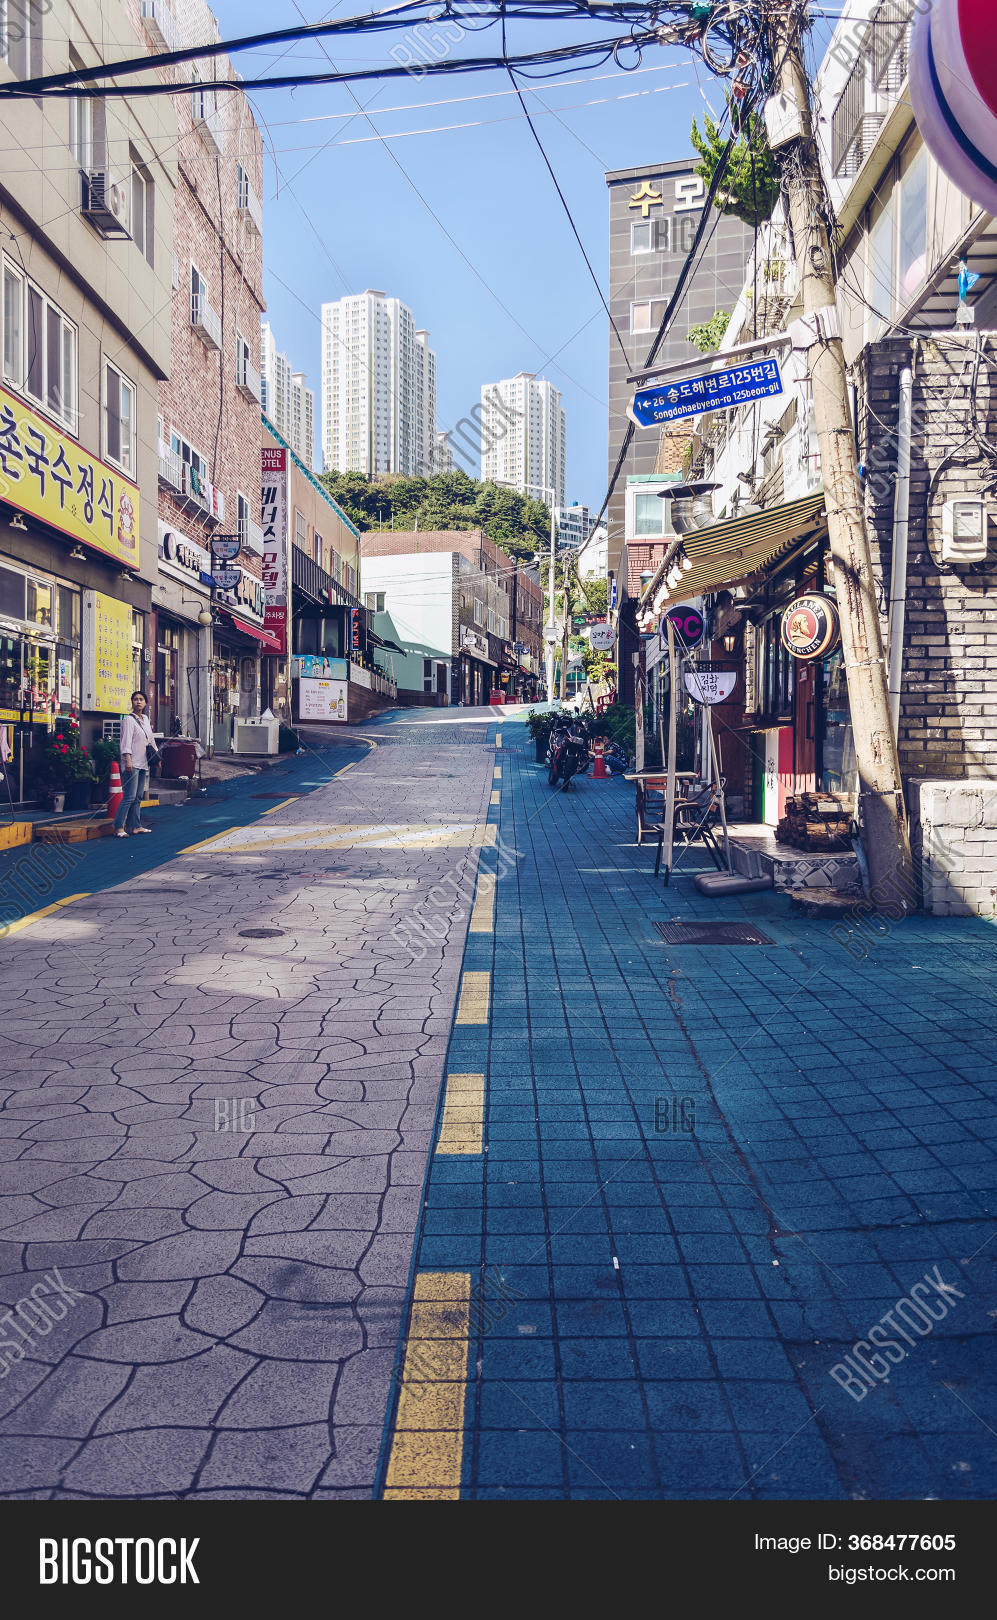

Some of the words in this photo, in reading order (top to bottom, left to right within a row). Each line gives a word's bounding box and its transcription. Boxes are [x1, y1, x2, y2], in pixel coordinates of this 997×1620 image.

[653, 395, 732, 421] Songdohaebyeon-ro
[733, 382, 780, 401] 125beon-gil
[667, 363, 778, 404] 송도해변로125번길
